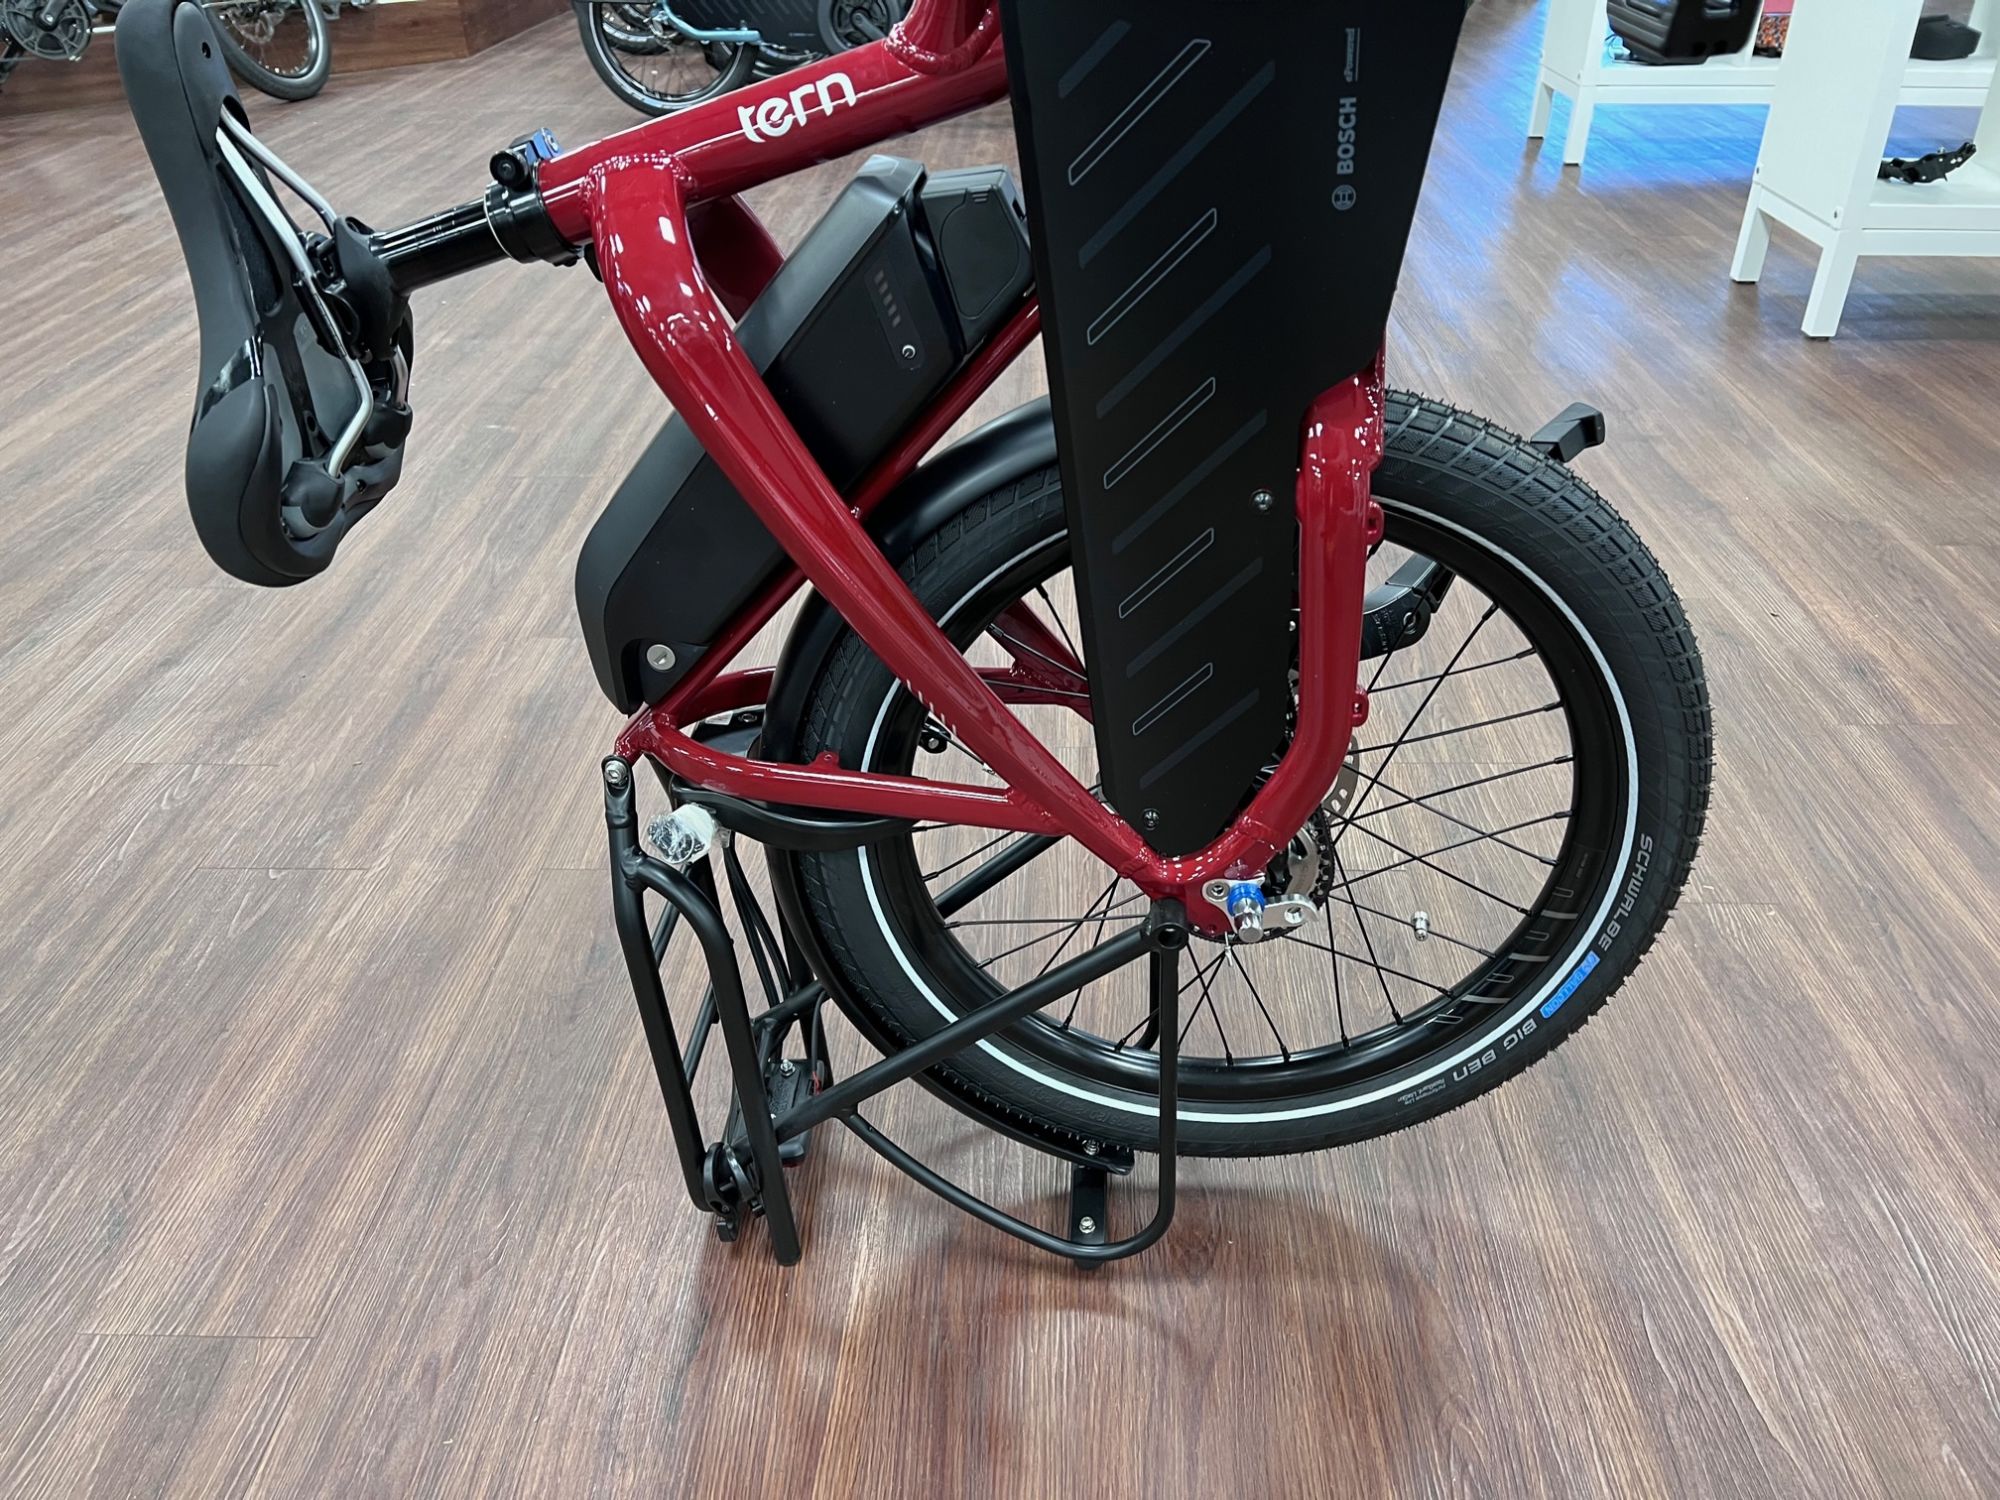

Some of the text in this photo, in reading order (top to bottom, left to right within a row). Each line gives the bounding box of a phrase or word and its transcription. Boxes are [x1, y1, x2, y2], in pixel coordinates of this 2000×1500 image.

[737, 72, 857, 143] tern
[1336, 97, 1357, 175] BOSCH
[1598, 833, 1653, 952] SCHWALBE
[1452, 1018, 1538, 1082] BIG BEN
